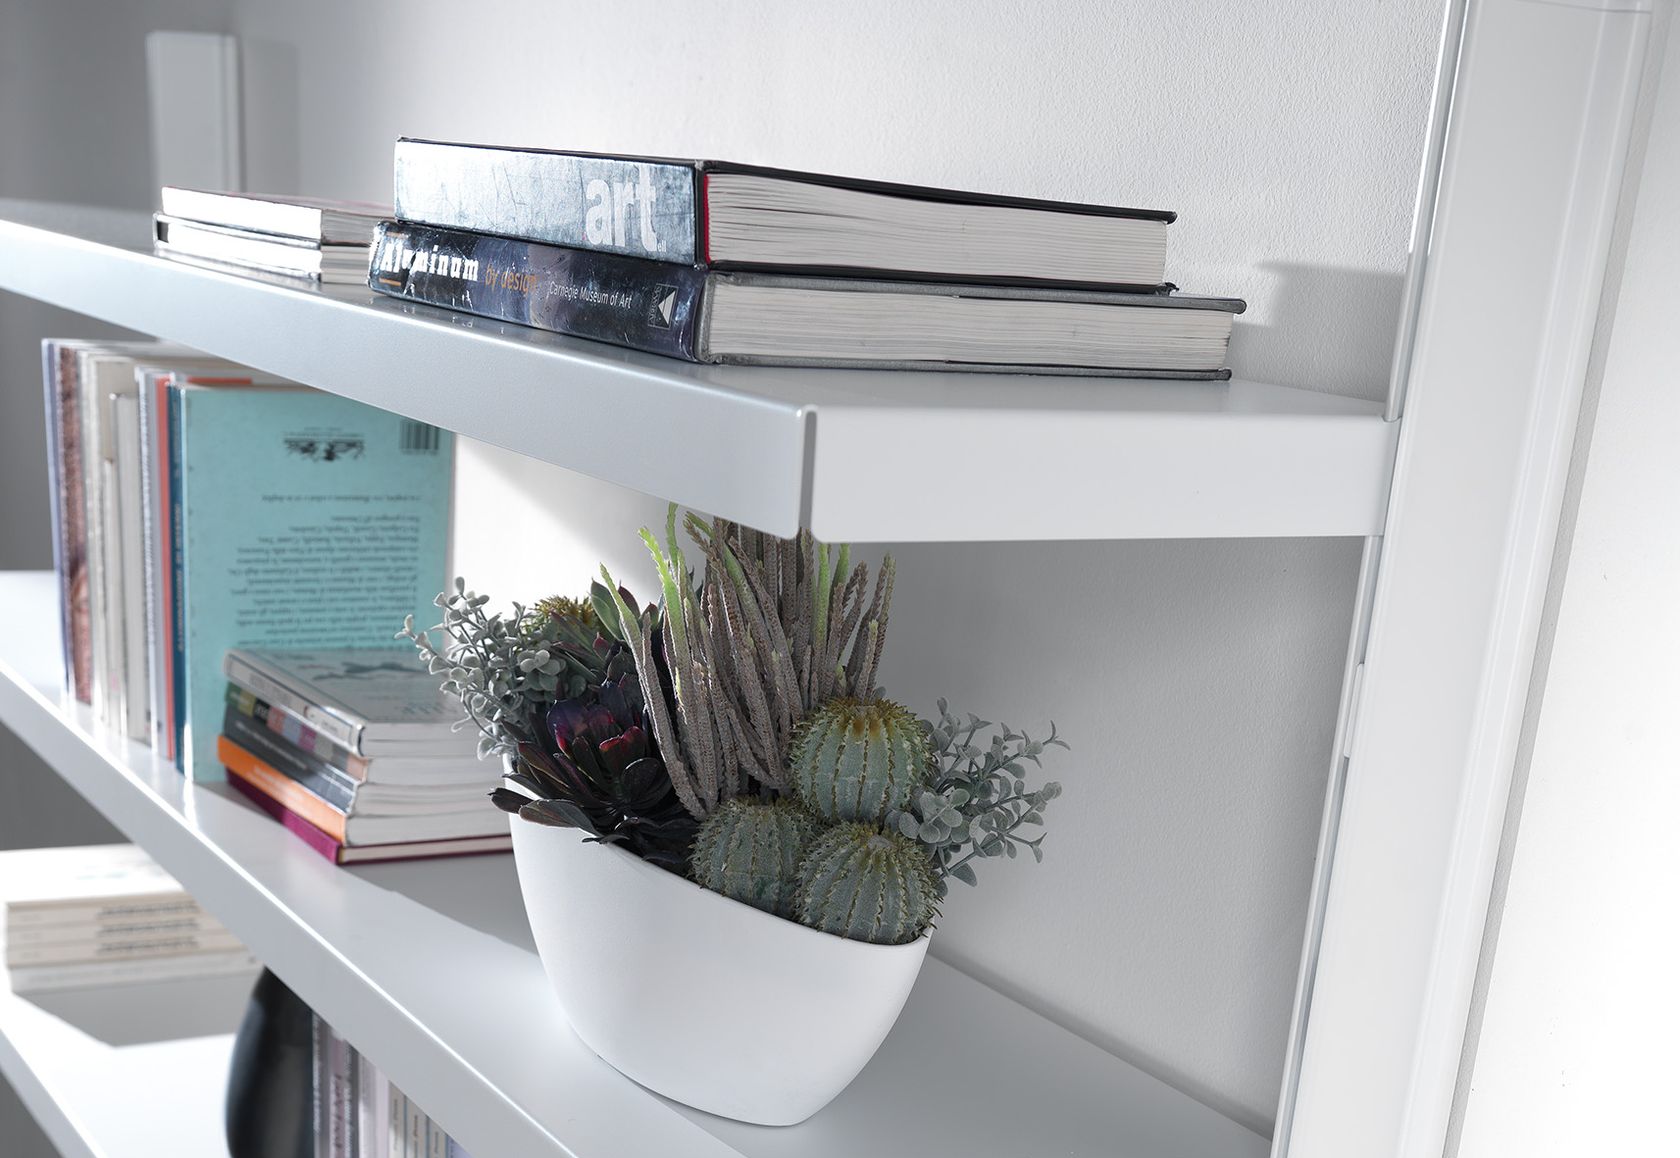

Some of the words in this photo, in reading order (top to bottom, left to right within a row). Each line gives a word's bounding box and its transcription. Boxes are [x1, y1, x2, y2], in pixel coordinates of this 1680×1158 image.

[585, 164, 657, 252] art
[486, 262, 498, 291] by
[501, 266, 538, 295] design
[549, 281, 579, 301] Carnegie
[580, 287, 608, 305] Museum
[610, 292, 618, 306] of
[619, 293, 632, 309] Art
